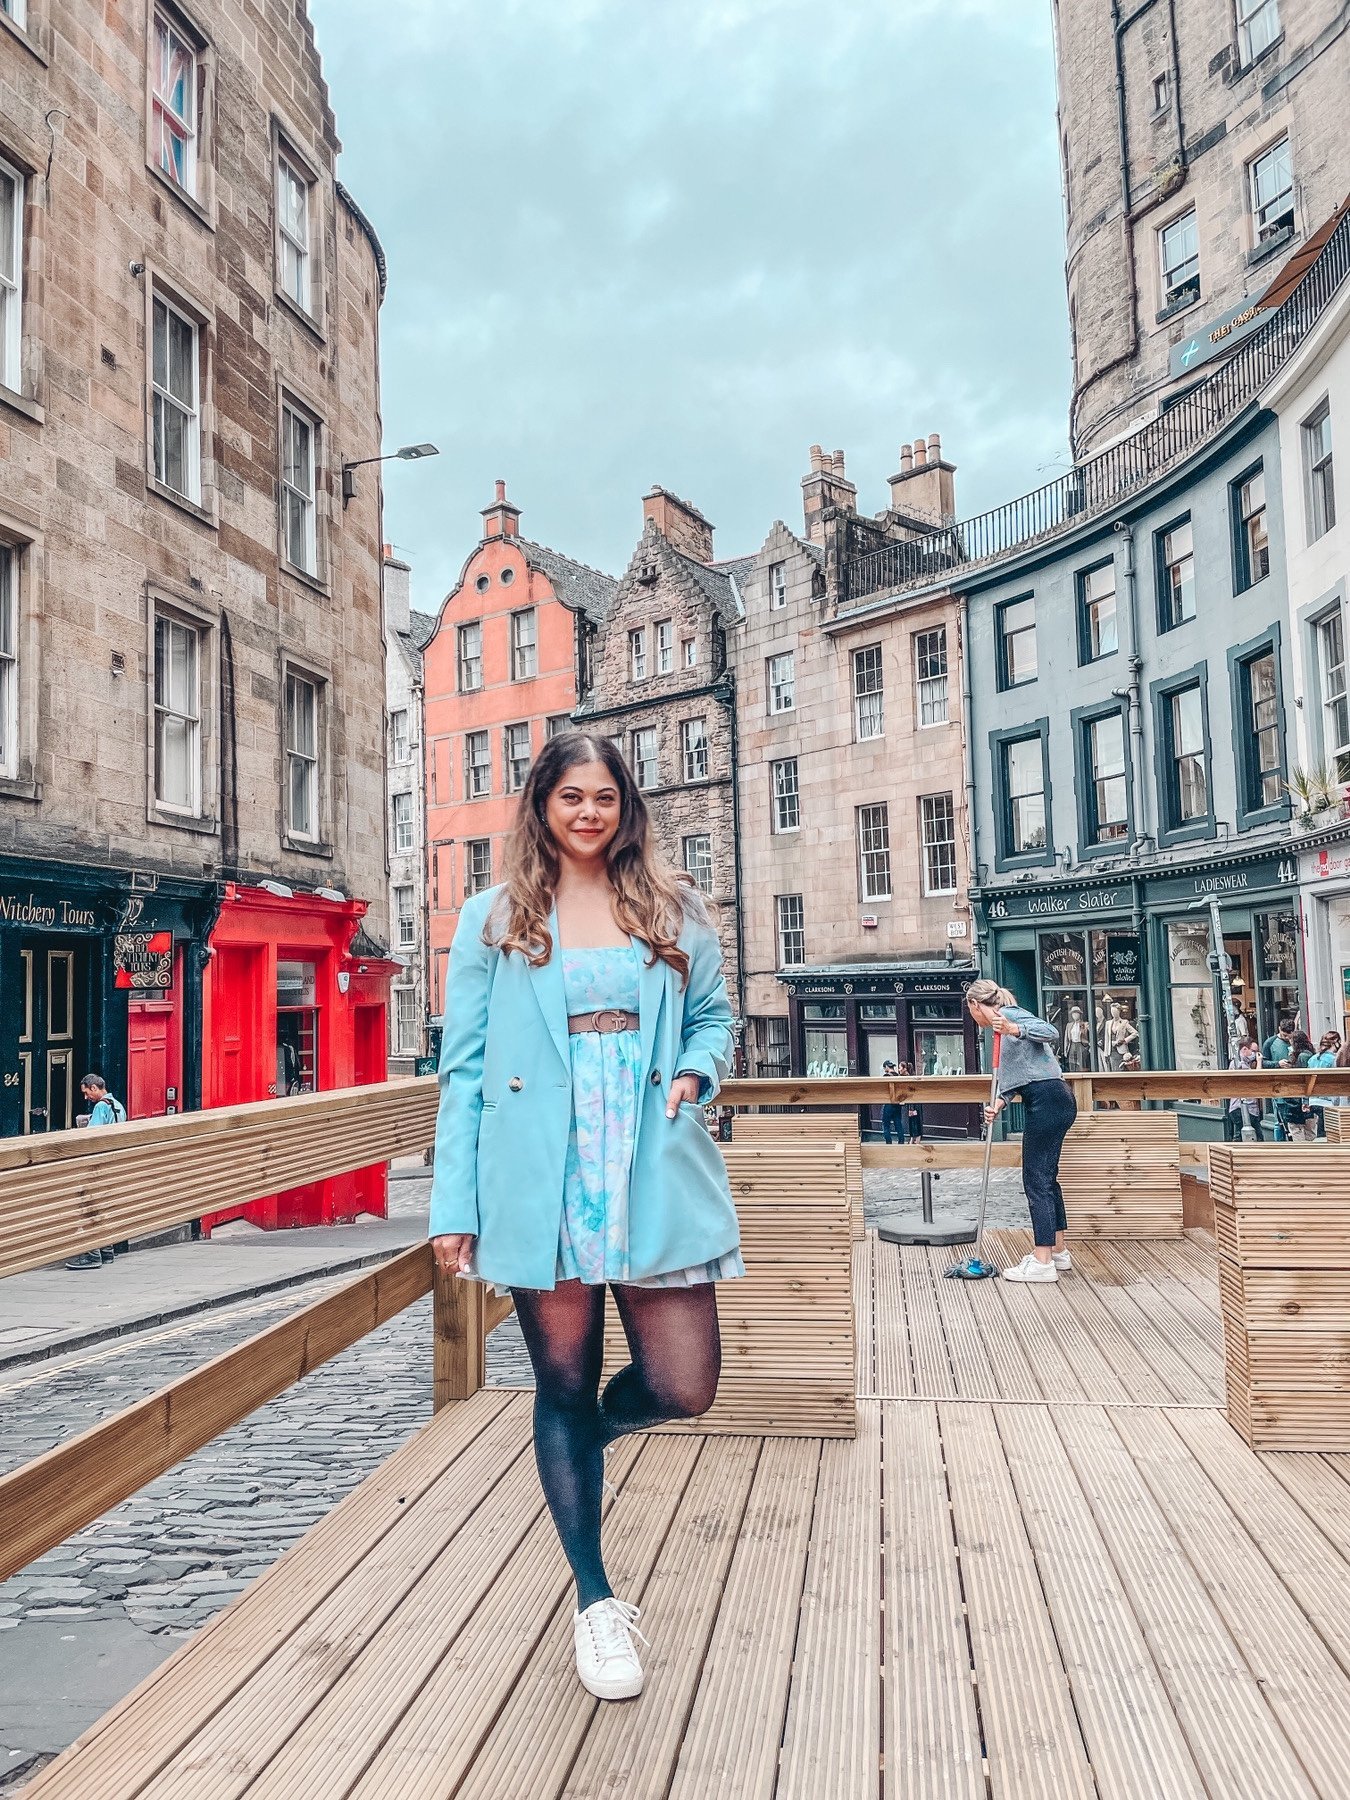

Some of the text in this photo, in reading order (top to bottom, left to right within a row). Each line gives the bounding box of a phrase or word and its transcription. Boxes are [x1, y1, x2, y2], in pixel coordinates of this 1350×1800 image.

[1194, 873, 1248, 893] LADIESWEAR
[59, 900, 95, 926] Tours
[1028, 891, 1118, 913] Walker Slater
